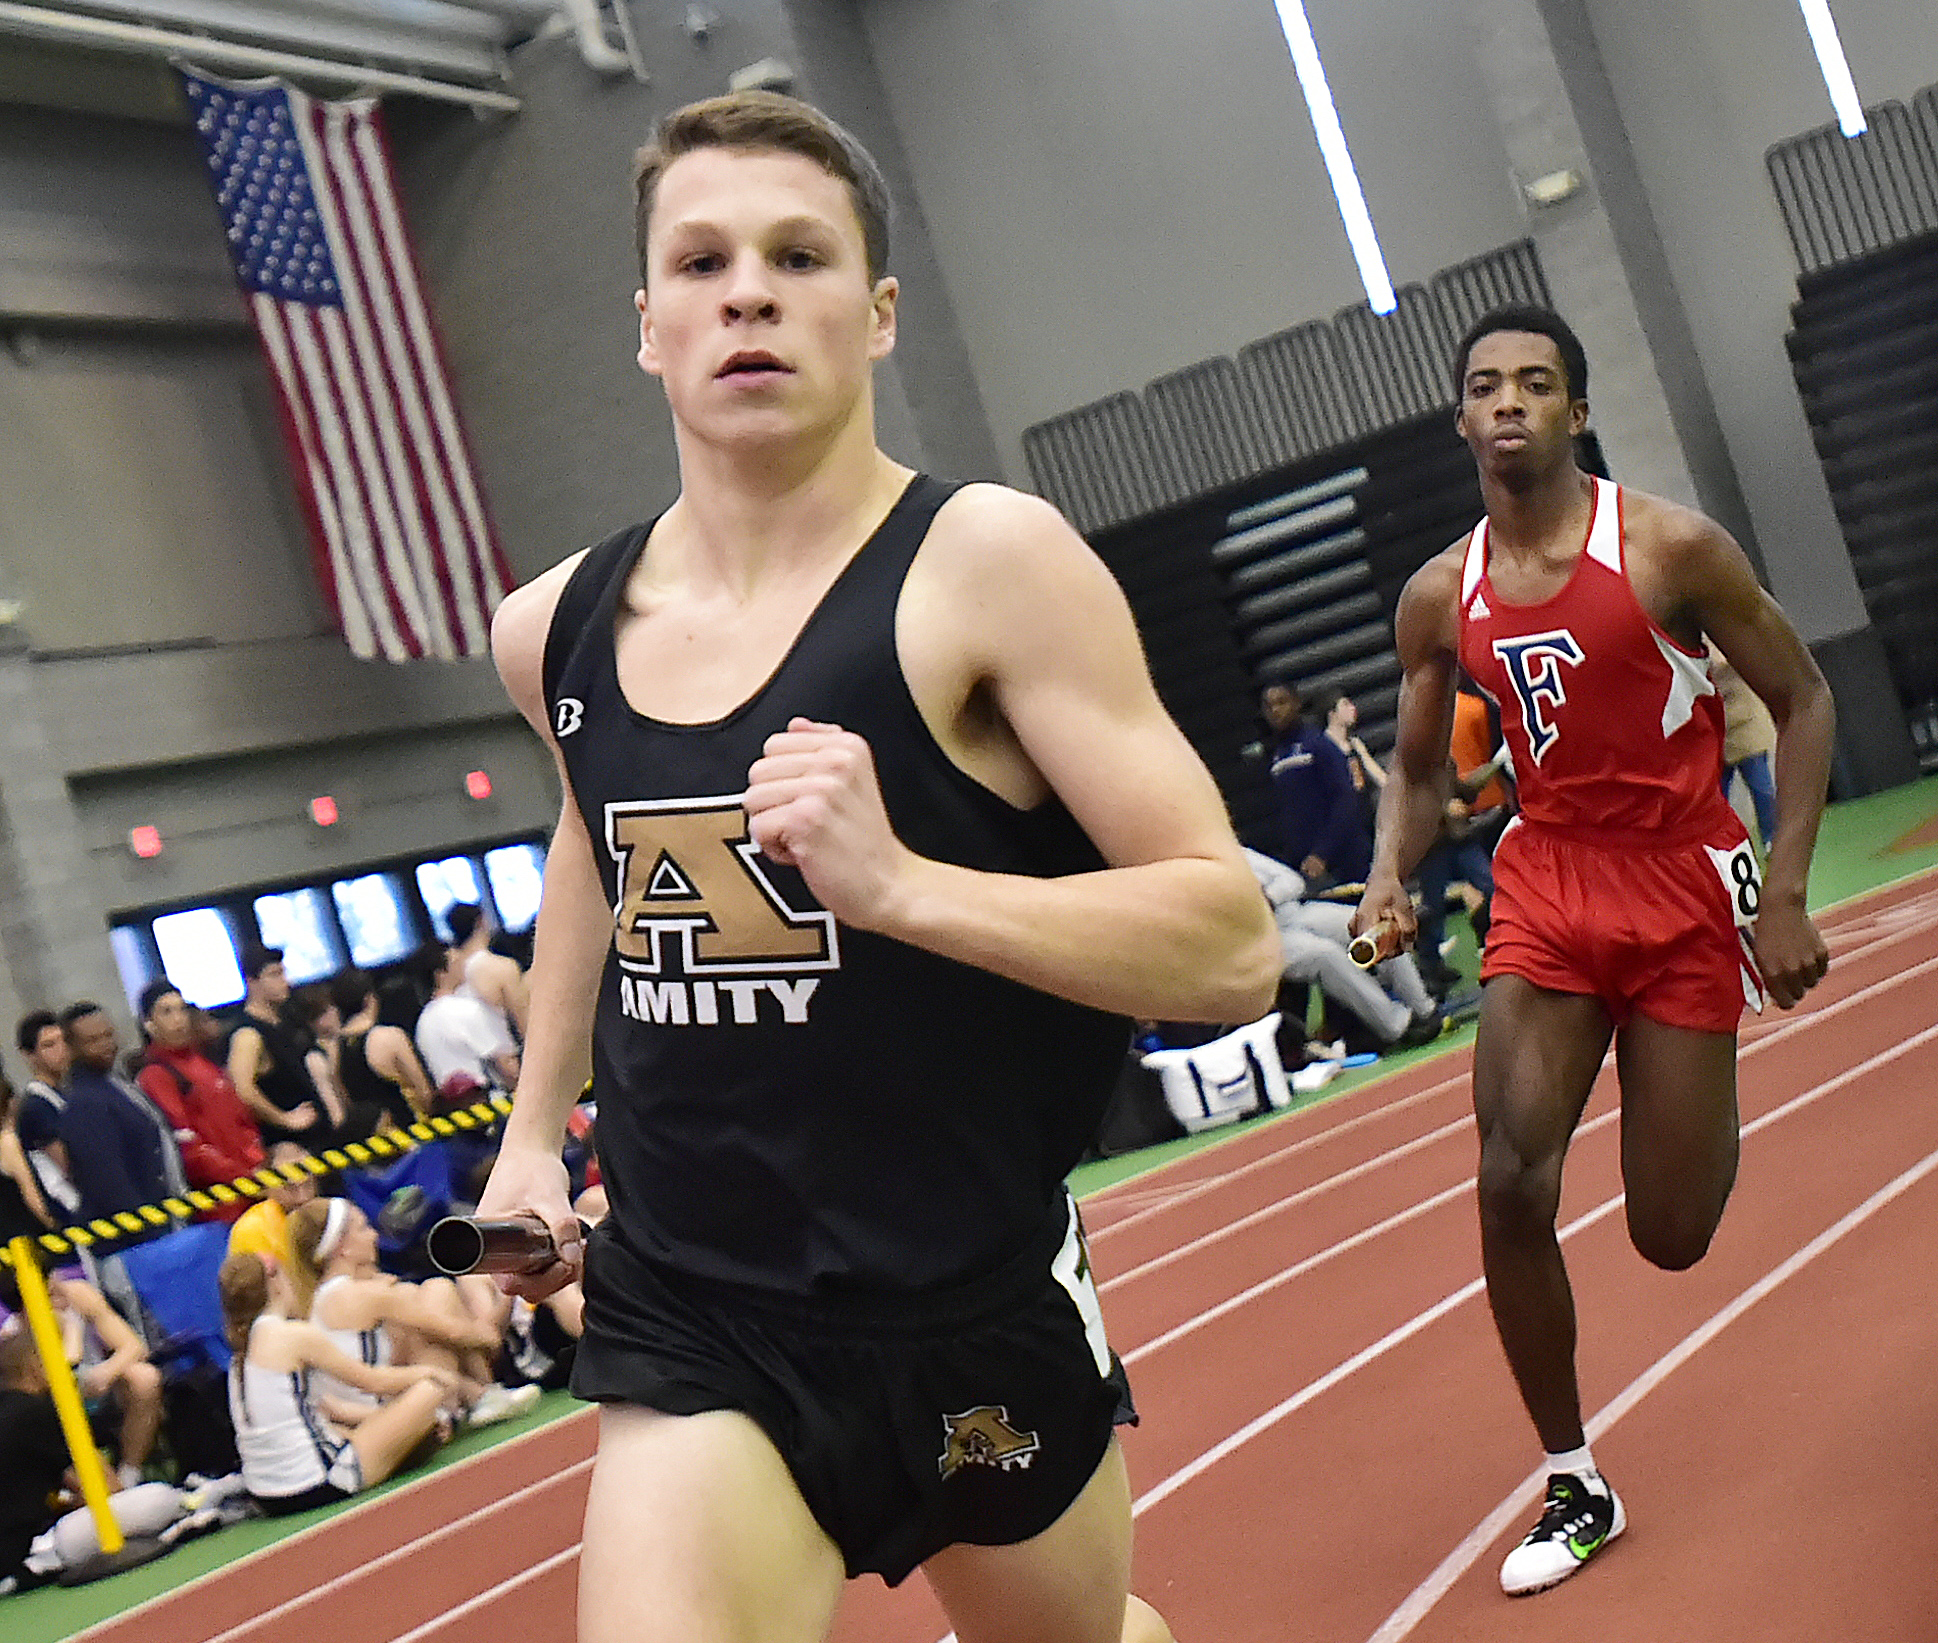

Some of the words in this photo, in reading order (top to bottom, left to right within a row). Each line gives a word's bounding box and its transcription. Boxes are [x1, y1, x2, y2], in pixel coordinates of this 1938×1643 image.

[1492, 628, 1585, 767] F
[604, 793, 841, 974] A
[1731, 852, 1760, 916] 8
[620, 975, 821, 1025] AMITY
